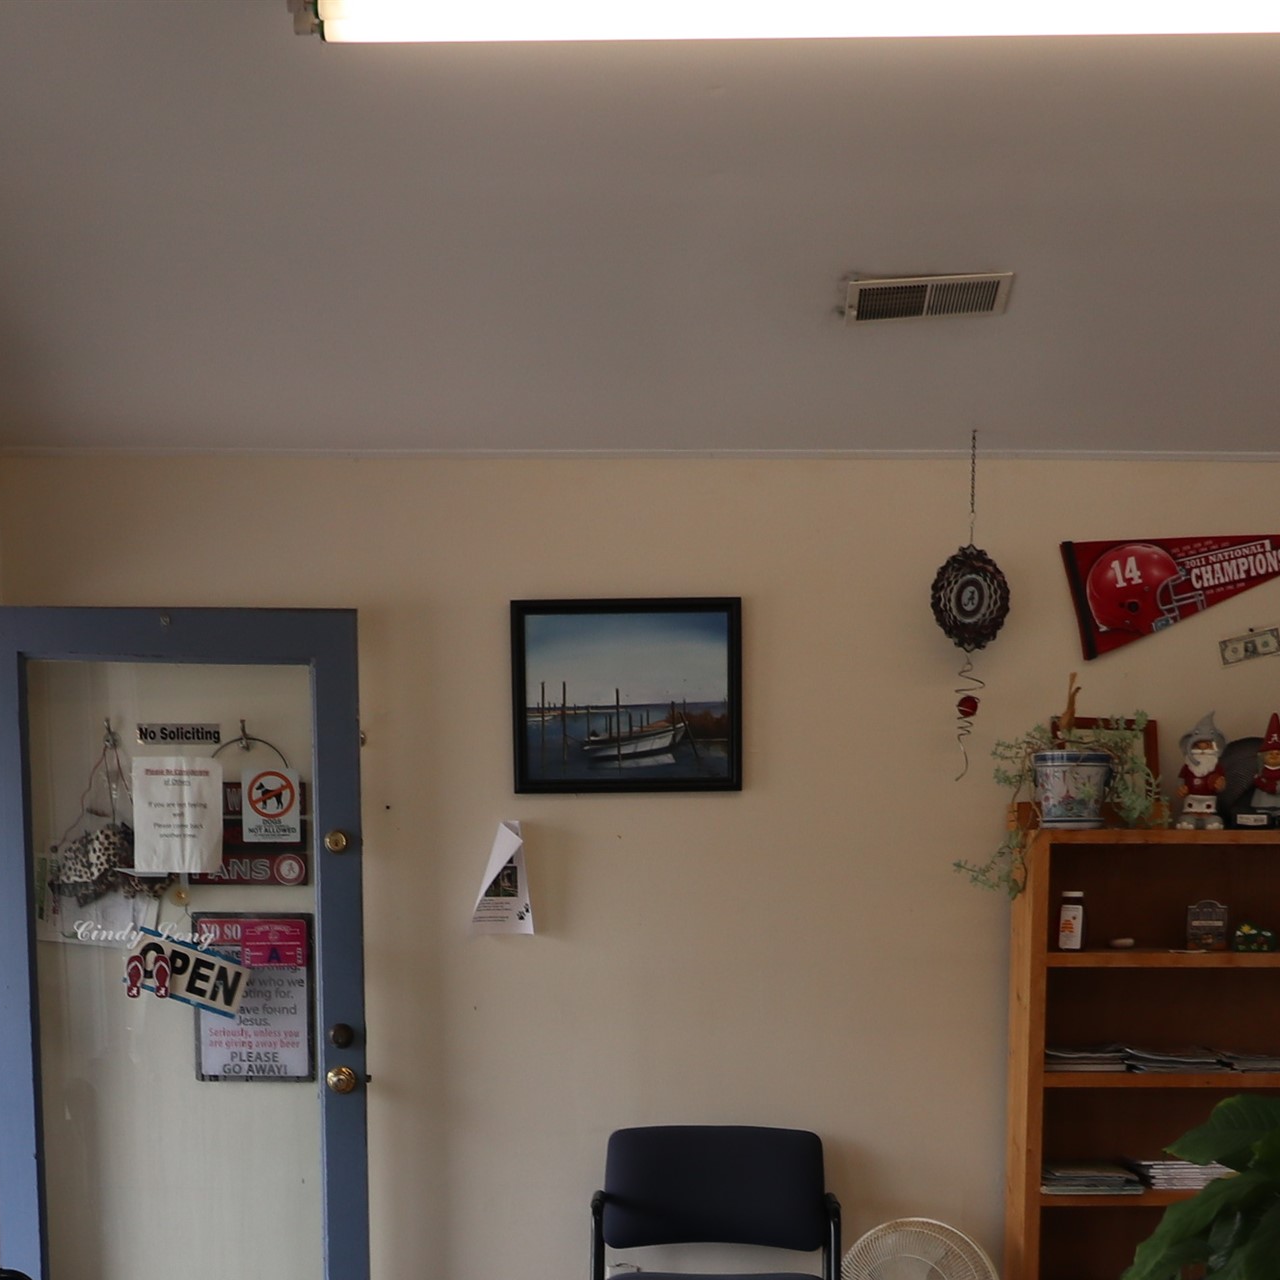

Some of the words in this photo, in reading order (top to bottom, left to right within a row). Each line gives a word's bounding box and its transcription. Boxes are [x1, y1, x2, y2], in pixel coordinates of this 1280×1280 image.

[1184, 558, 1206, 569] 2011
[1208, 544, 1265, 564] NATIONAL
[1110, 556, 1143, 588] 14
[139, 727, 156, 741] No
[160, 726, 220, 744] Soliciting
[192, 859, 271, 880] ANS
[73, 920, 144, 949] Cindy
[154, 920, 215, 950] Long
[139, 942, 242, 1008] OPEN
[258, 977, 284, 987] who
[287, 978, 305, 987] we
[239, 1005, 260, 1014] ave
[262, 1004, 297, 1014] found
[237, 1016, 271, 1026] Jesus.
[254, 1028, 281, 1037] unless
[284, 1029, 300, 1039] you
[225, 1039, 253, 1050] giving
[279, 1038, 300, 1048] beer
[230, 1051, 280, 1063] PLEASE
[223, 1064, 242, 1075] GO
[246, 1064, 288, 1076] AWAY!
